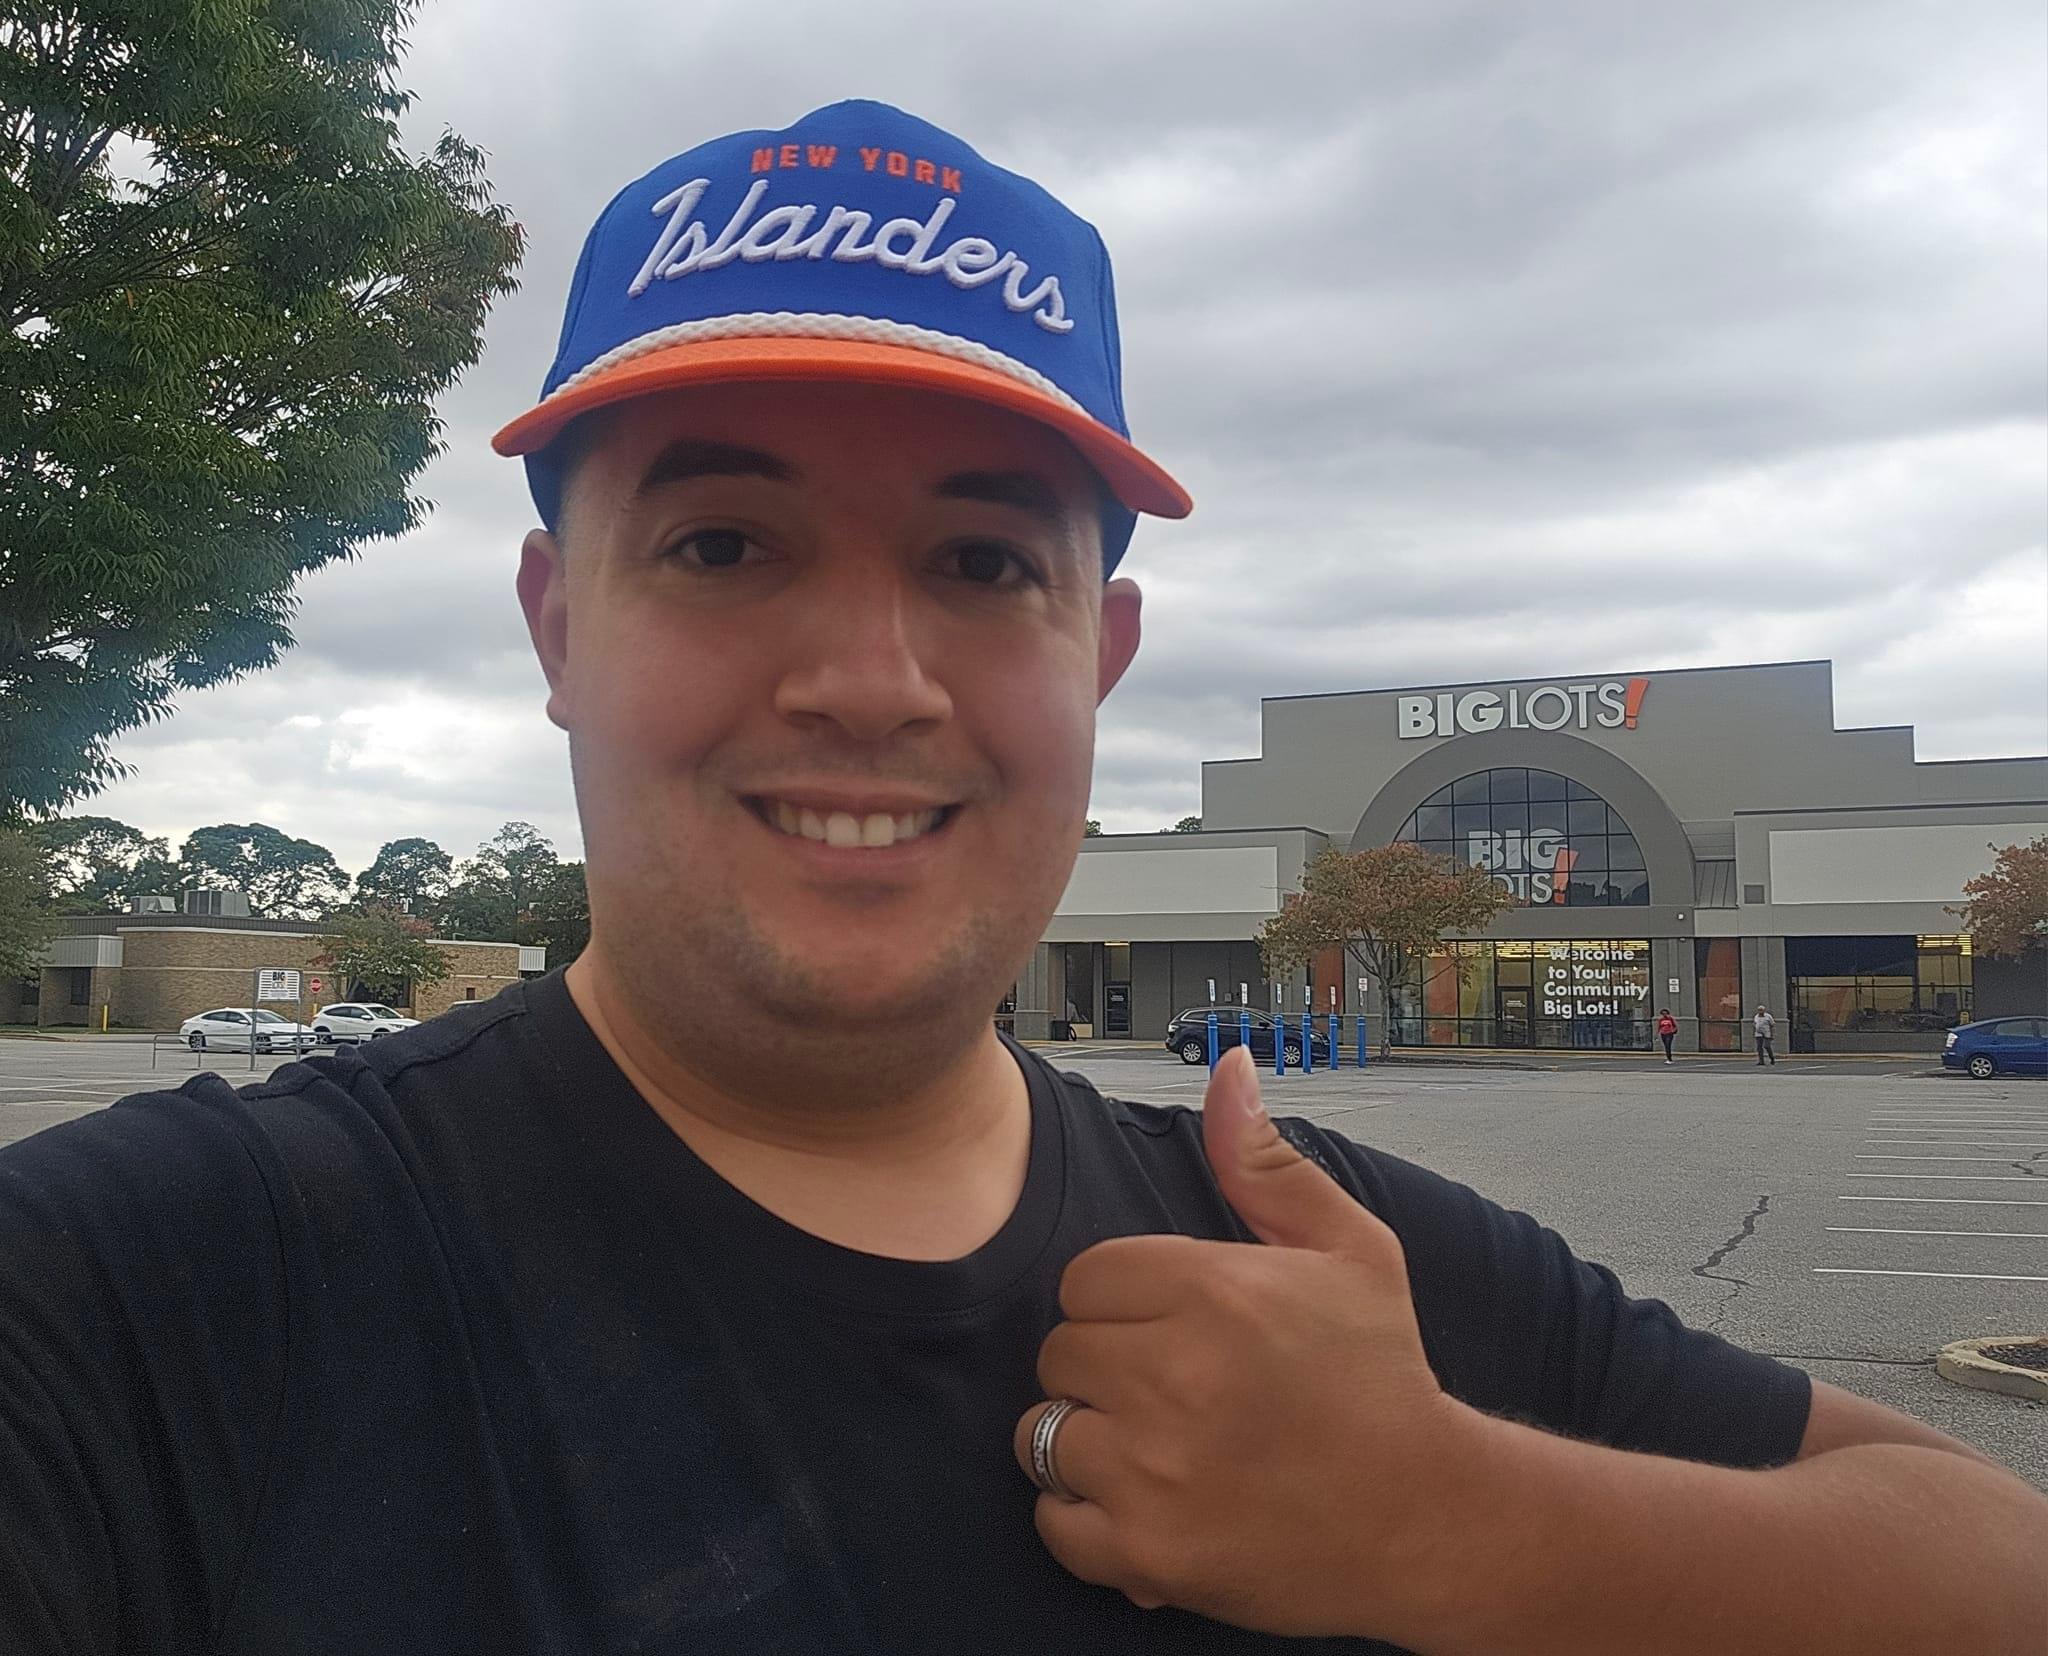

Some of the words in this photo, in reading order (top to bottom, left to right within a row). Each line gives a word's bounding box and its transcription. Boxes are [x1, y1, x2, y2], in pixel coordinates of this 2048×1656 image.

[751, 145, 838, 173] NEW
[860, 147, 964, 193] YORK
[627, 178, 1075, 334] Islanders
[1468, 828, 1568, 870] BIG
[1549, 946, 1635, 960] Welcome
[1548, 966, 1567, 979] to
[1572, 964, 1615, 979] Your
[1543, 981, 1649, 1001] Community
[1544, 999, 1572, 1019] Big
[1577, 999, 1618, 1015] Lots!
